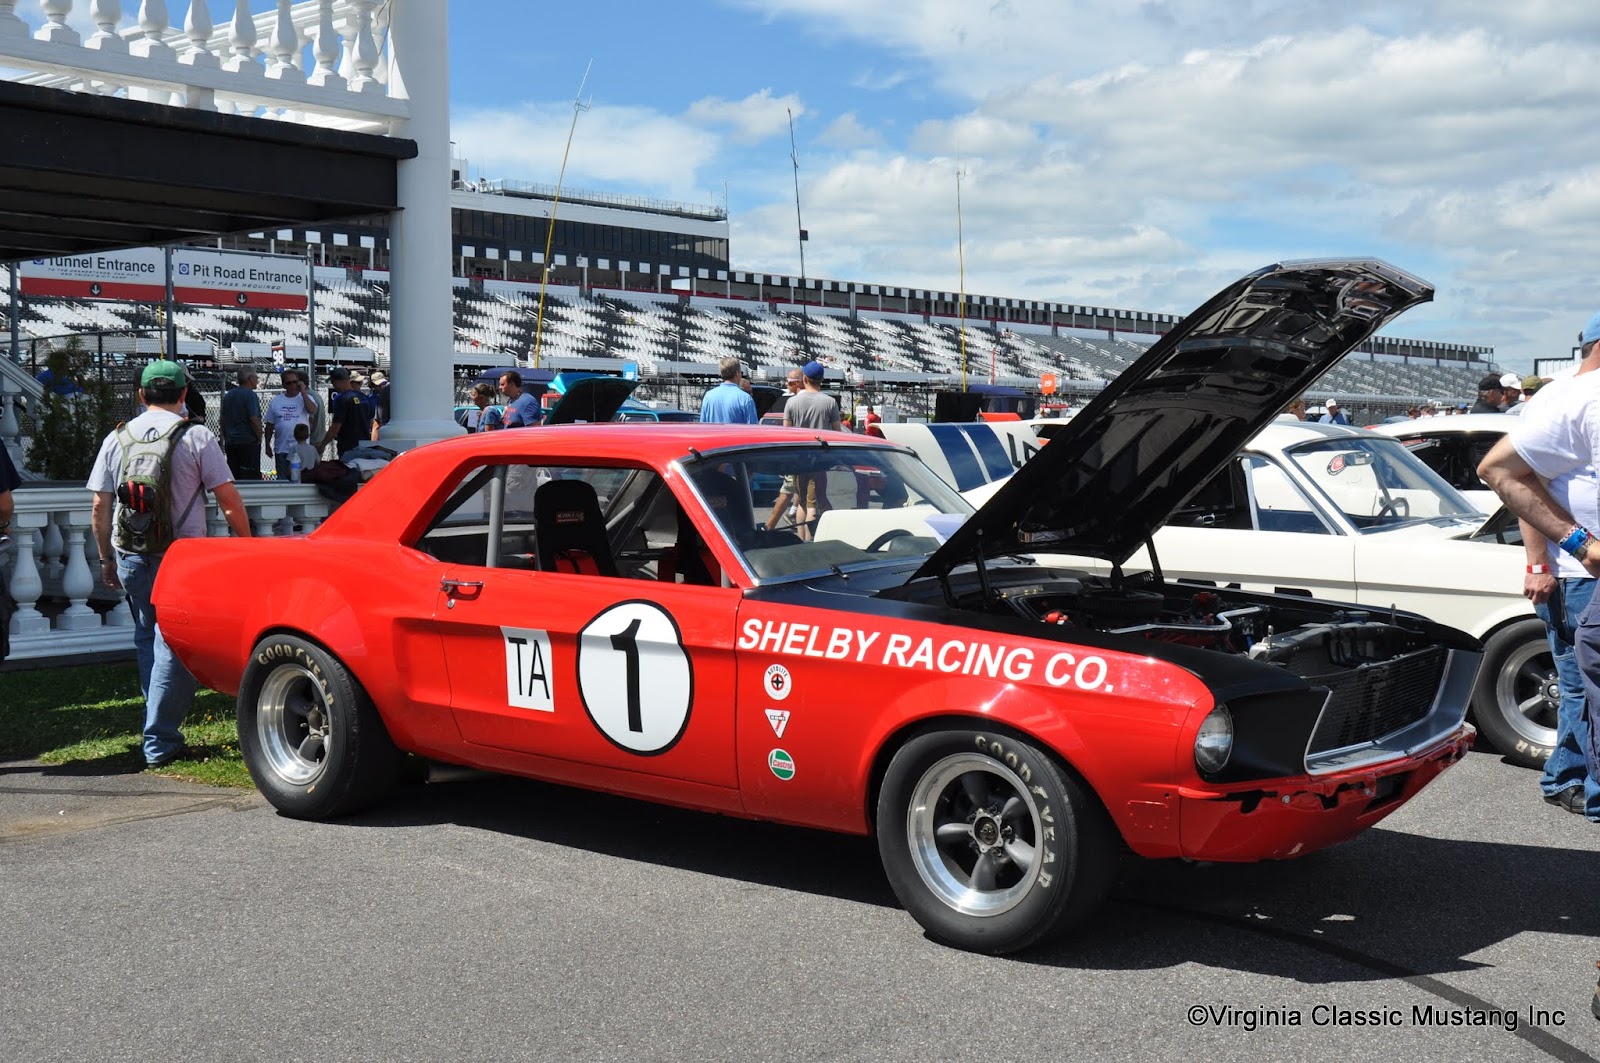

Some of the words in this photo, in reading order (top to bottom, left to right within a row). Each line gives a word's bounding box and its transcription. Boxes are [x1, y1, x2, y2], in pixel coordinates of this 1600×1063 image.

[49, 256, 93, 269] Tunnel
[97, 258, 156, 273] Entrance
[193, 264, 210, 277] Pit
[213, 266, 245, 280] Road
[249, 269, 302, 284] Entrance
[273, 350, 284, 365] 98
[738, 618, 878, 662] SHELBY
[882, 633, 1034, 680] RACING
[1044, 651, 1114, 692] CO.
[508, 637, 551, 699] TA
[610, 619, 643, 733] 1
[767, 665, 788, 677] AUTOLITE
[773, 759, 793, 770] Castrol
